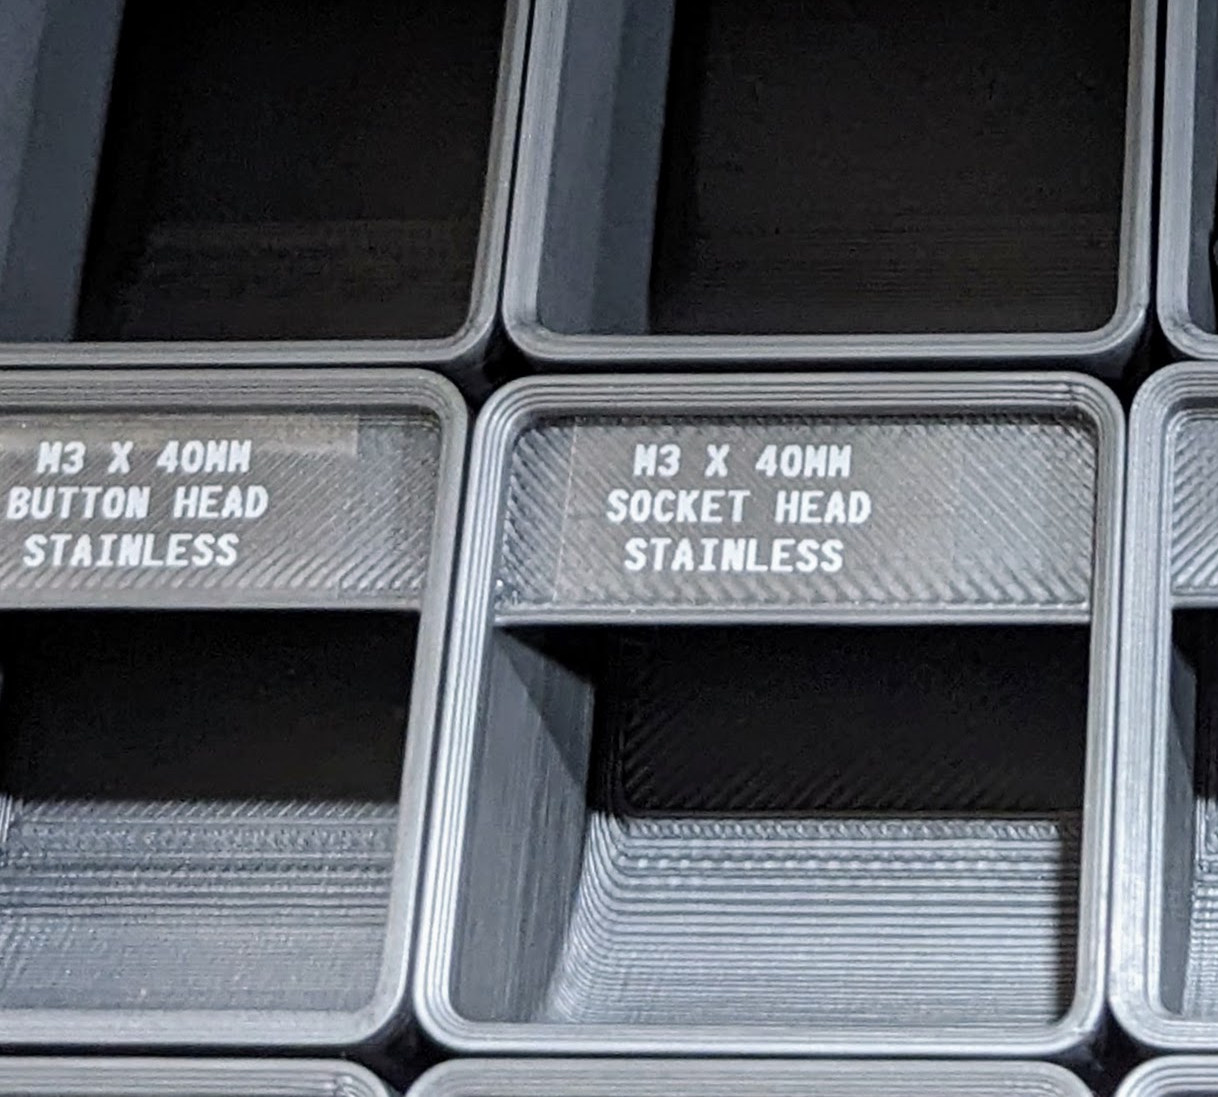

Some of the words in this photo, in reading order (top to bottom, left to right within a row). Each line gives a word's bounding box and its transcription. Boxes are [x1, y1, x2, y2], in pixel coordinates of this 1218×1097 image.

[36, 441, 86, 474] M3
[108, 441, 134, 474] X
[156, 440, 251, 474] 40MM
[633, 444, 681, 477] M3
[704, 444, 730, 477] X
[756, 444, 852, 478] 40MM
[6, 486, 150, 520] BUTTON
[173, 485, 269, 518] HEAD
[606, 488, 751, 524] SOCKET
[775, 490, 872, 524] HEAD
[23, 533, 240, 568] STAINLESS
[624, 537, 844, 572] STAINLESS
